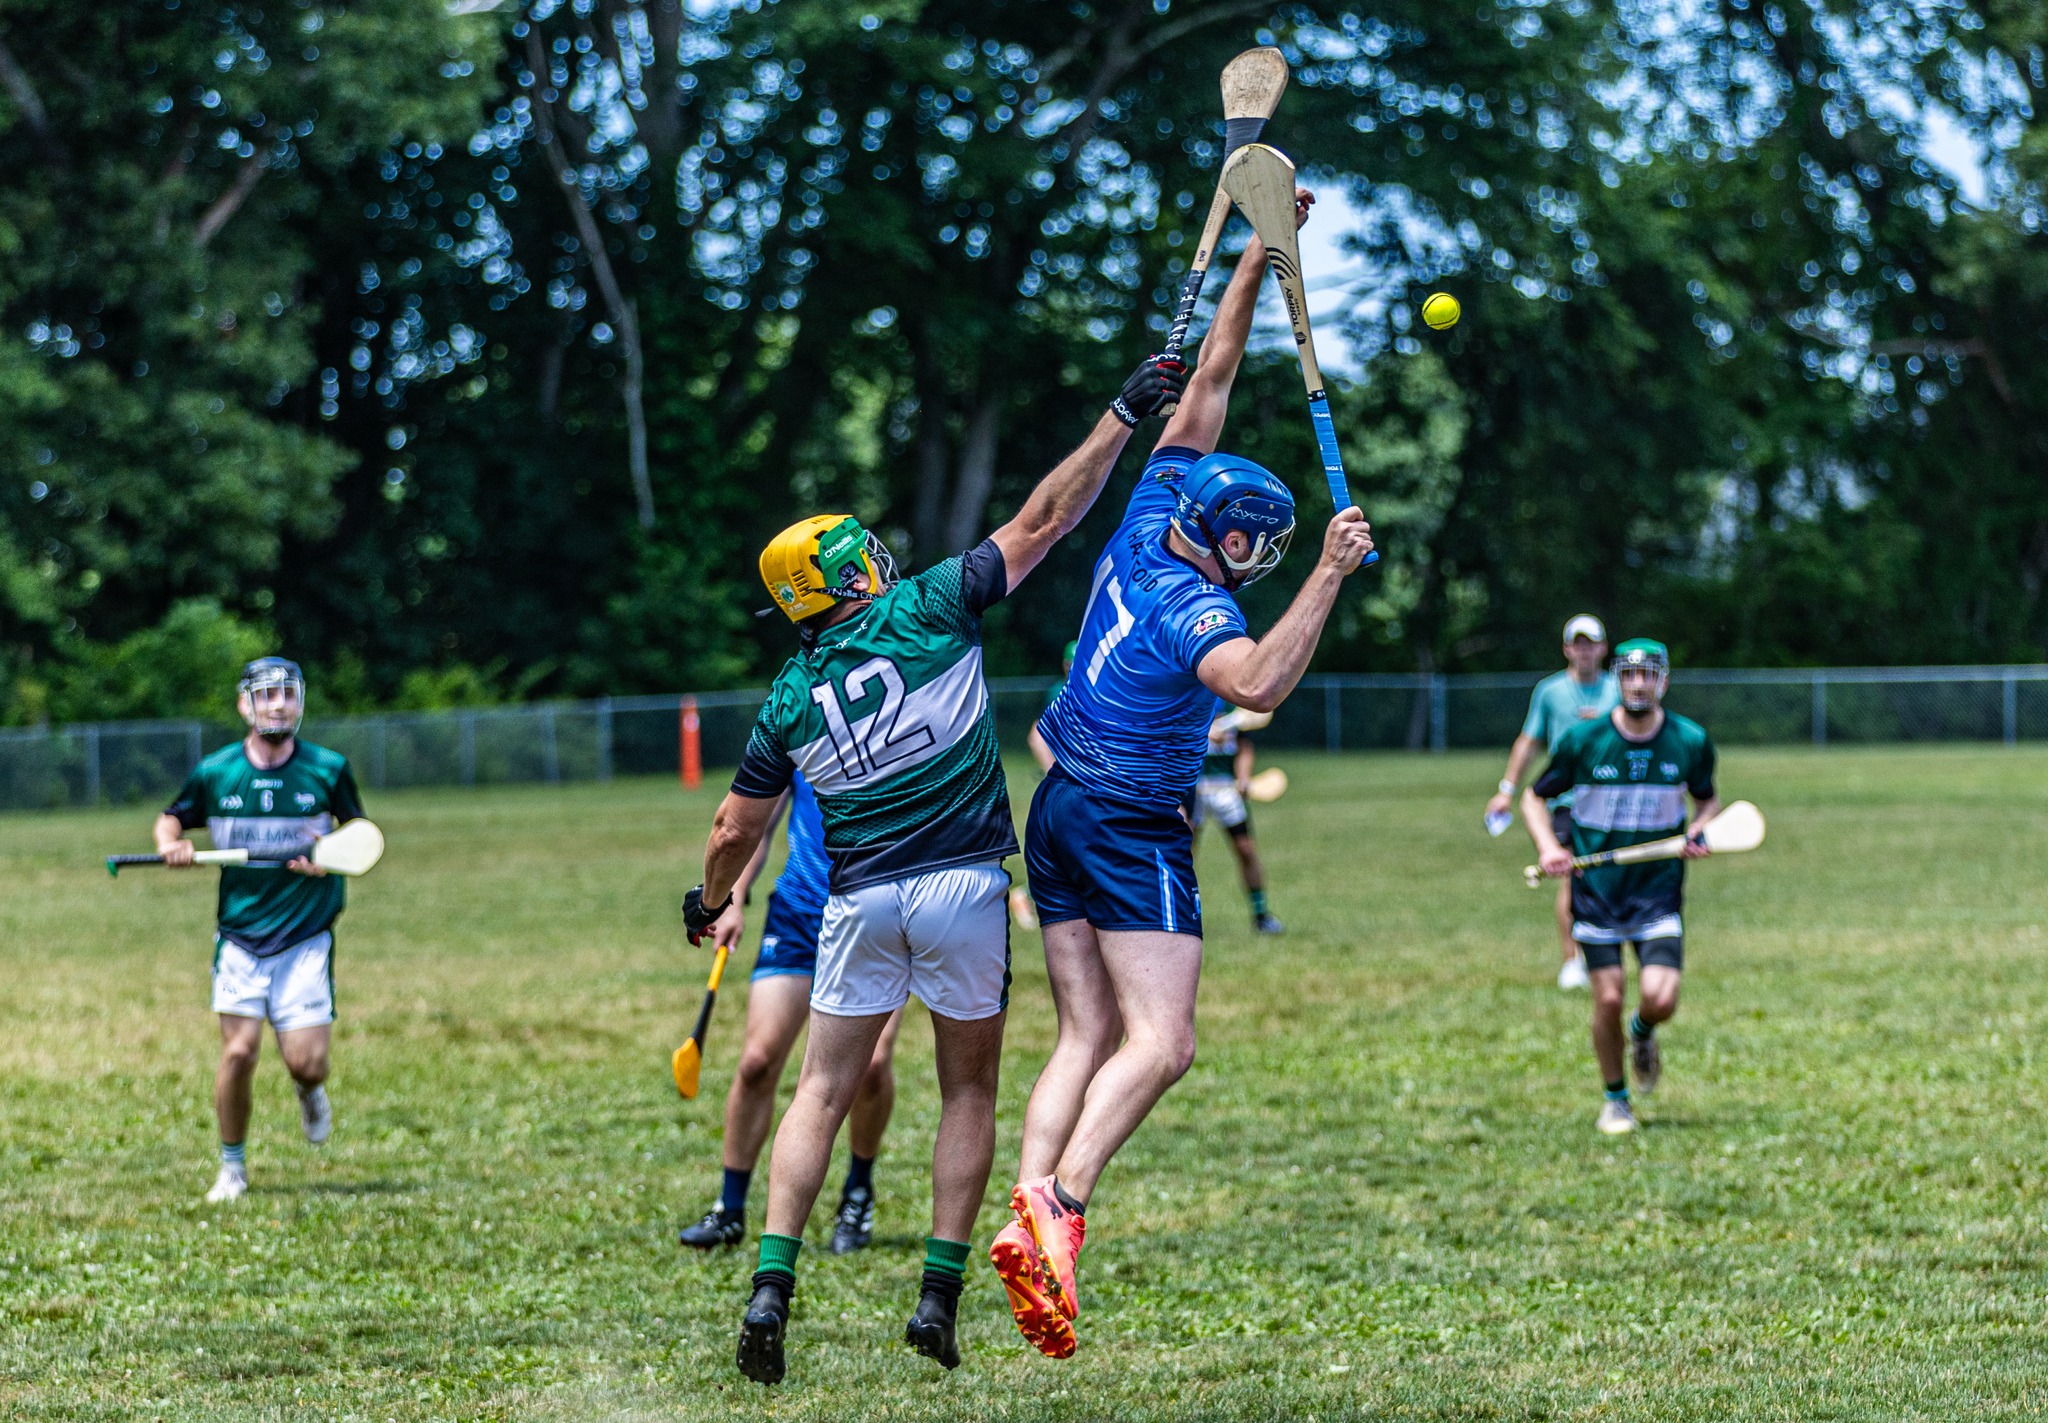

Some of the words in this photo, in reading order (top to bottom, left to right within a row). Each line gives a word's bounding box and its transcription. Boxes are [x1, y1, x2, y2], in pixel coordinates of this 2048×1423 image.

[1285, 286, 1300, 328] TORPEY
[824, 534, 853, 559] O'Neills
[809, 654, 937, 781] 12
